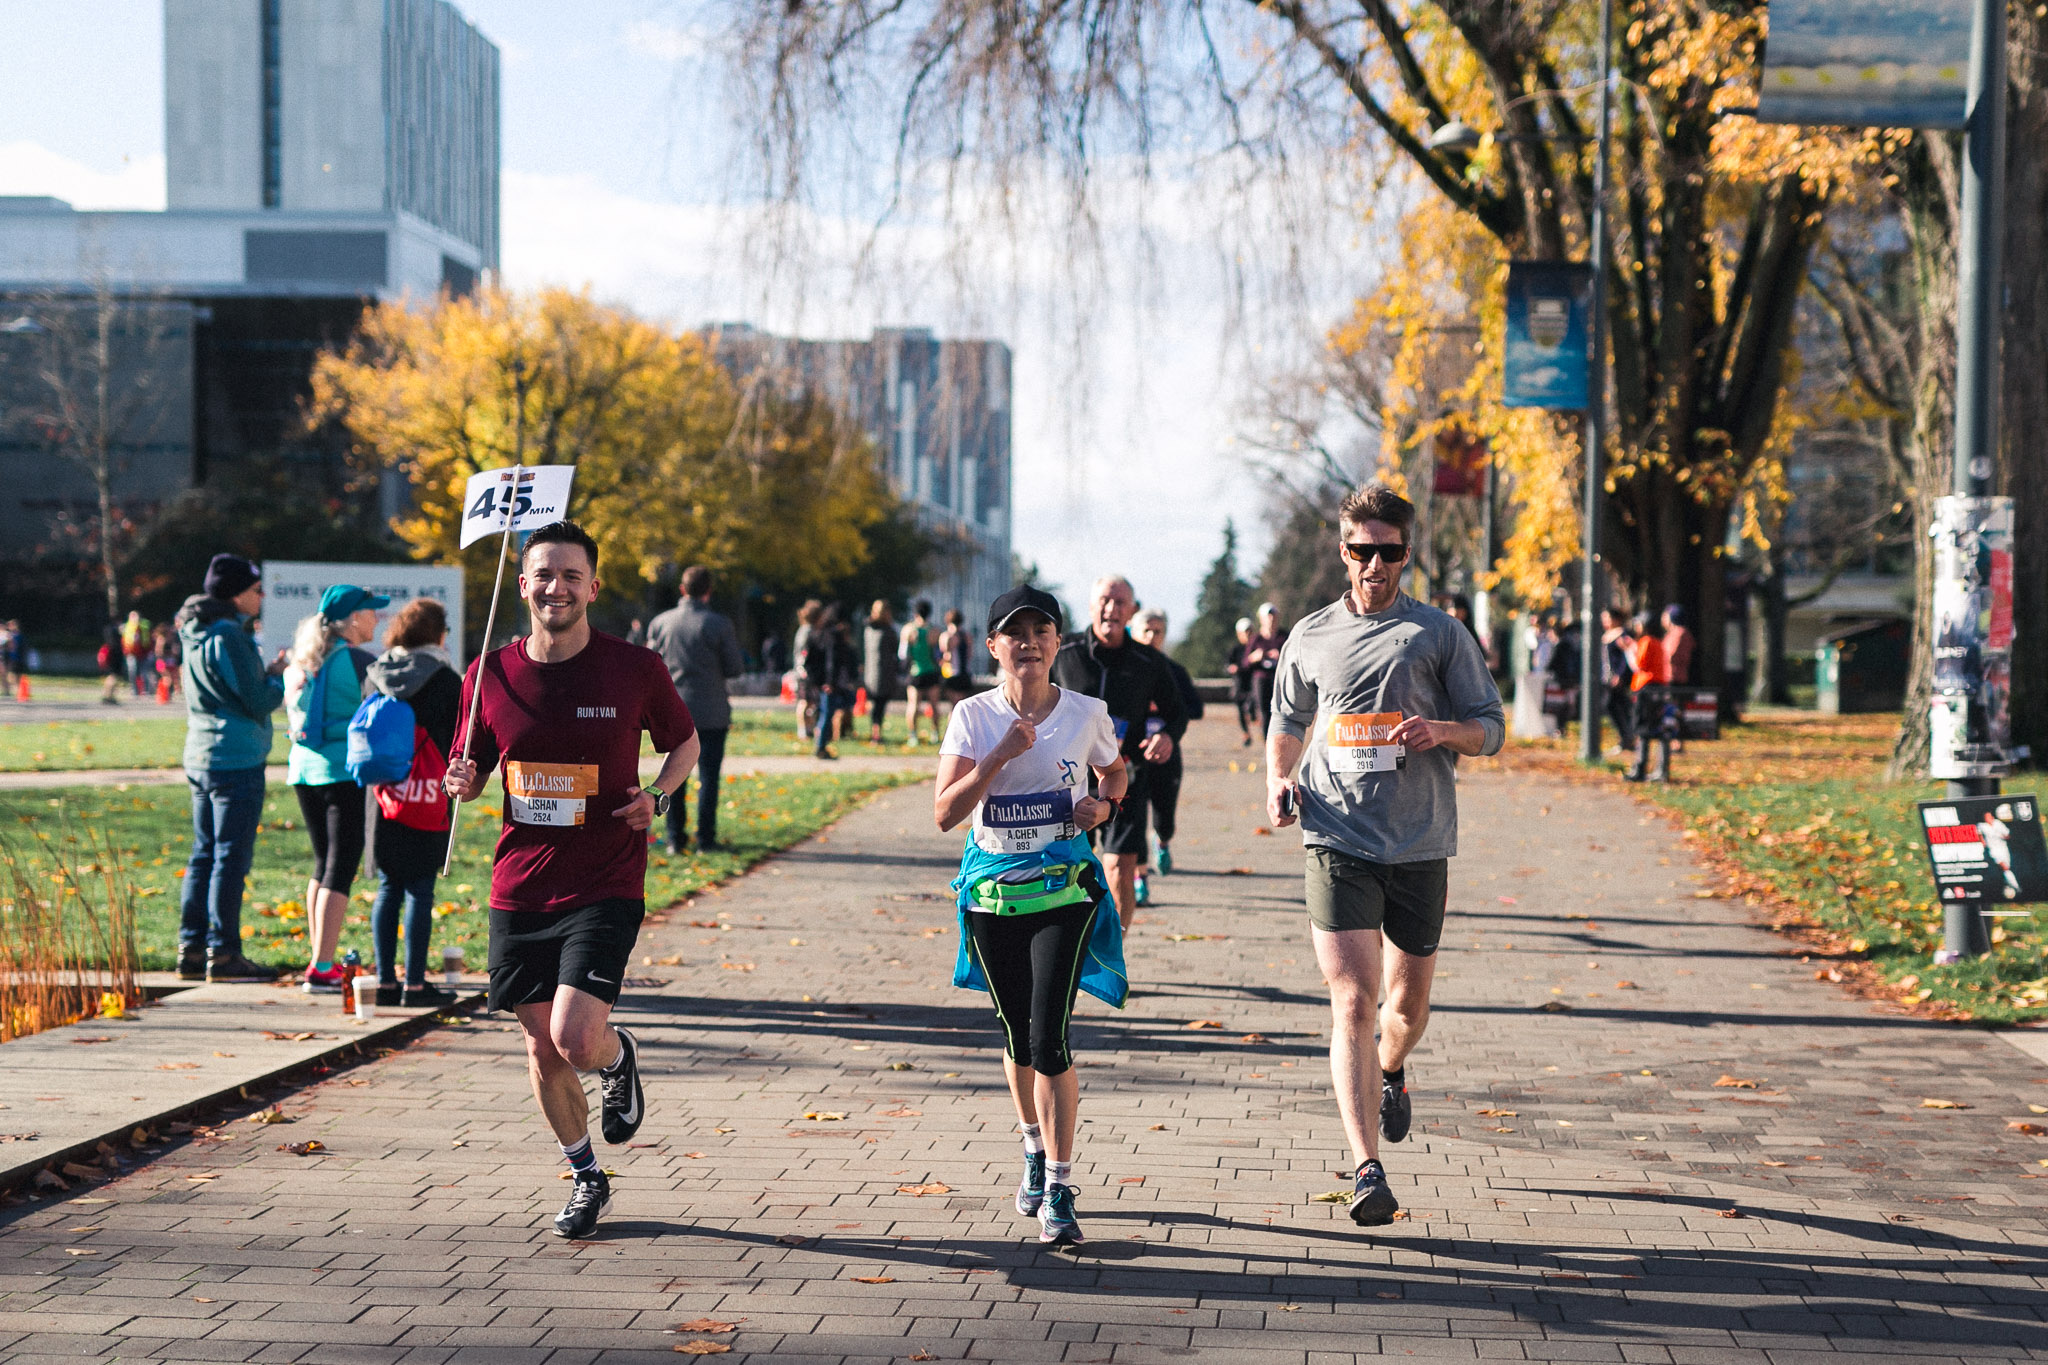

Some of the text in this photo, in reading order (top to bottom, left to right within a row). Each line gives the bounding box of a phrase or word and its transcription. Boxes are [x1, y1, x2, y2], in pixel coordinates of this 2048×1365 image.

[468, 486, 555, 519] 45 MIN
[1352, 747, 1377, 759] CONOR
[1356, 760, 1374, 769] 2919
[528, 799, 558, 811] LISHAN
[533, 812, 552, 822] 2524
[1007, 828, 1038, 840] A.CHEN
[1016, 841, 1030, 851] 893
